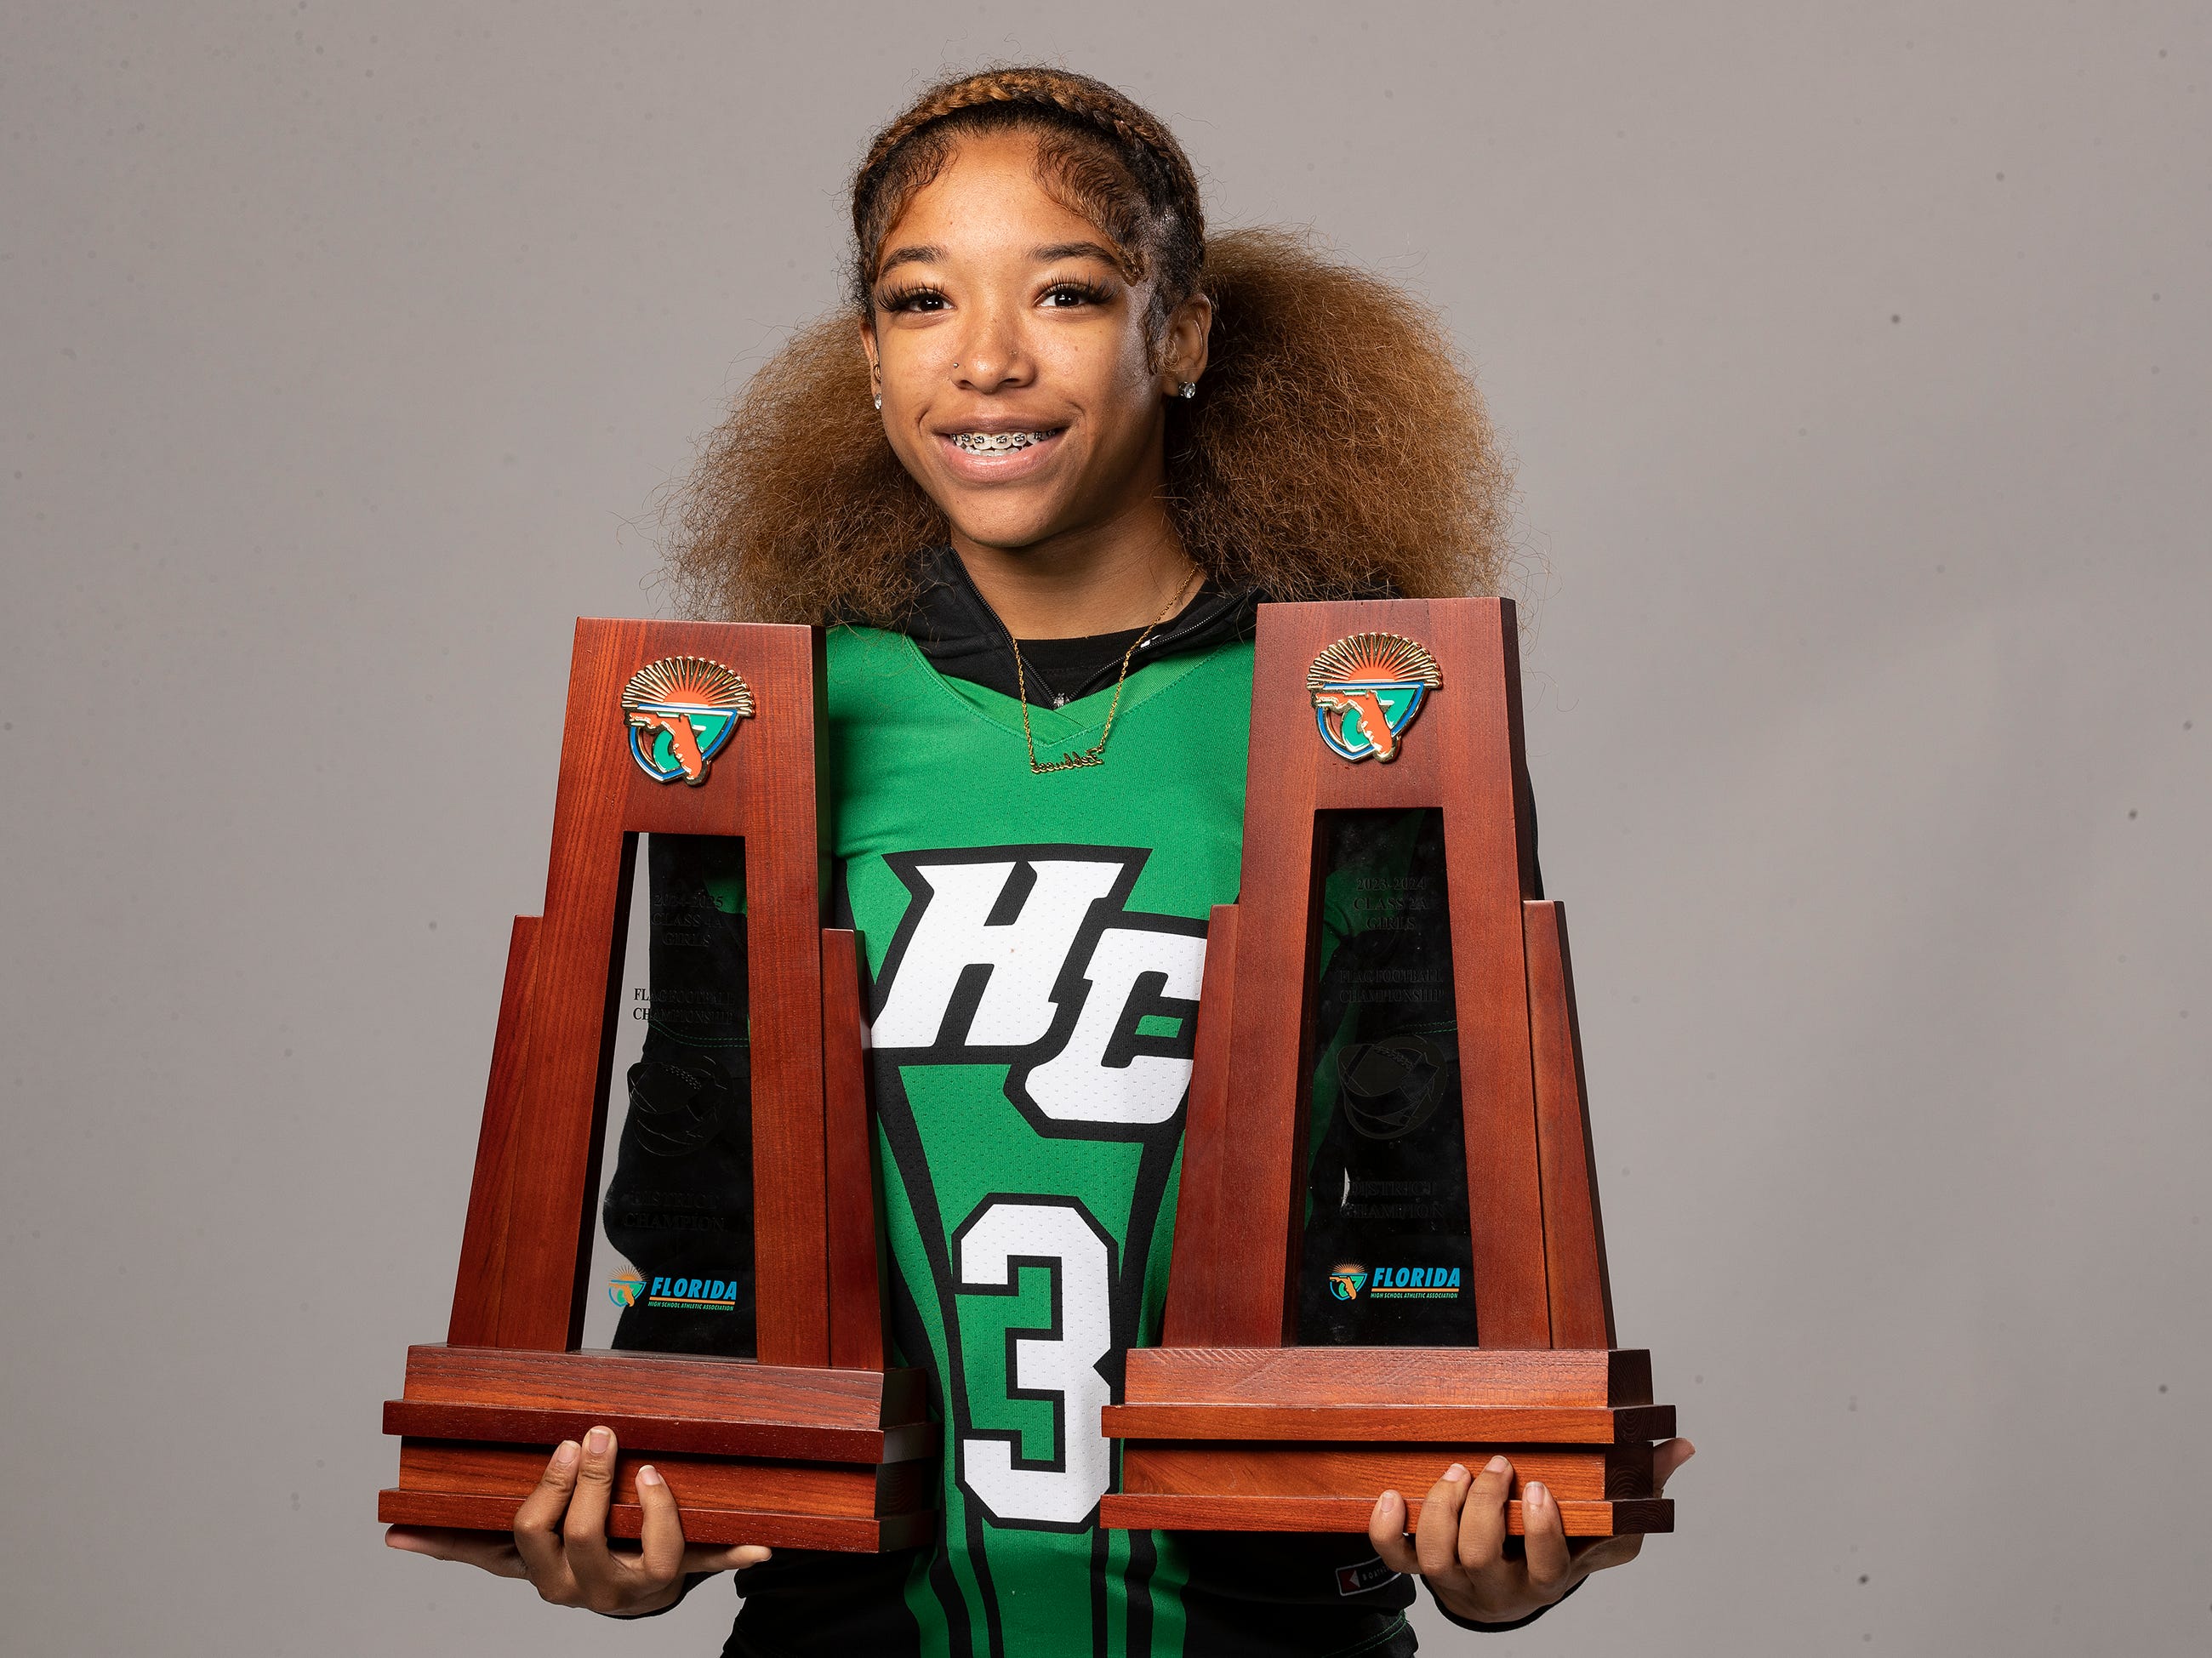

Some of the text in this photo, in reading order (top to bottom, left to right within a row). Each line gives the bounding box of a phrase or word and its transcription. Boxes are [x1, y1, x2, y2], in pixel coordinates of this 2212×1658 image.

[1354, 897, 1406, 911] CLASS
[1366, 917, 1417, 931] GIRLS
[871, 859, 1208, 1126] HC
[1372, 1267, 1461, 1288] FLORIDA
[650, 1277, 738, 1301] FLORIDA
[961, 1203, 1112, 1528] 3
